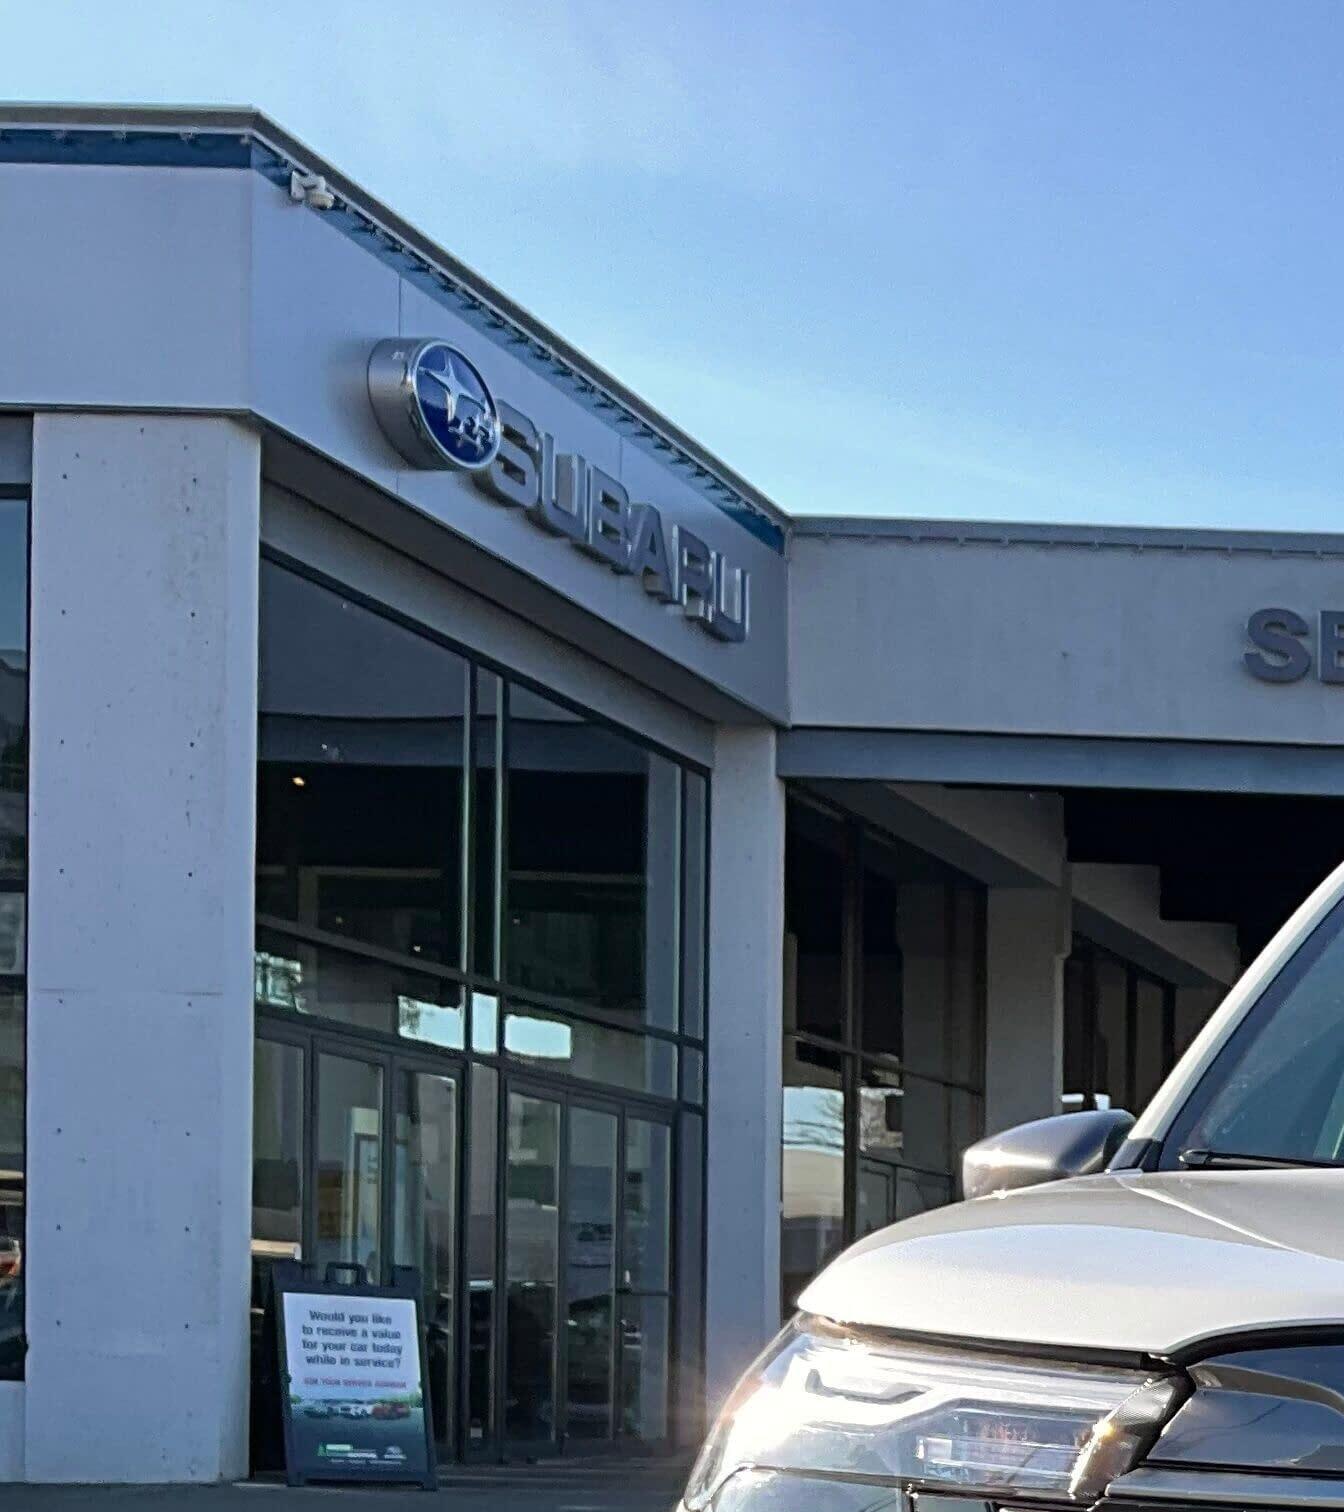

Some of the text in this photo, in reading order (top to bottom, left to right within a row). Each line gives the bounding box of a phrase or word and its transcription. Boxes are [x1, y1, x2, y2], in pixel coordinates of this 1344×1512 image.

[482, 398, 750, 643] SUBARU
[309, 1310, 392, 1325] Would you like
[302, 1325, 401, 1339] to receive a value
[302, 1340, 402, 1356] for your car today
[305, 1354, 401, 1369] while in service?
